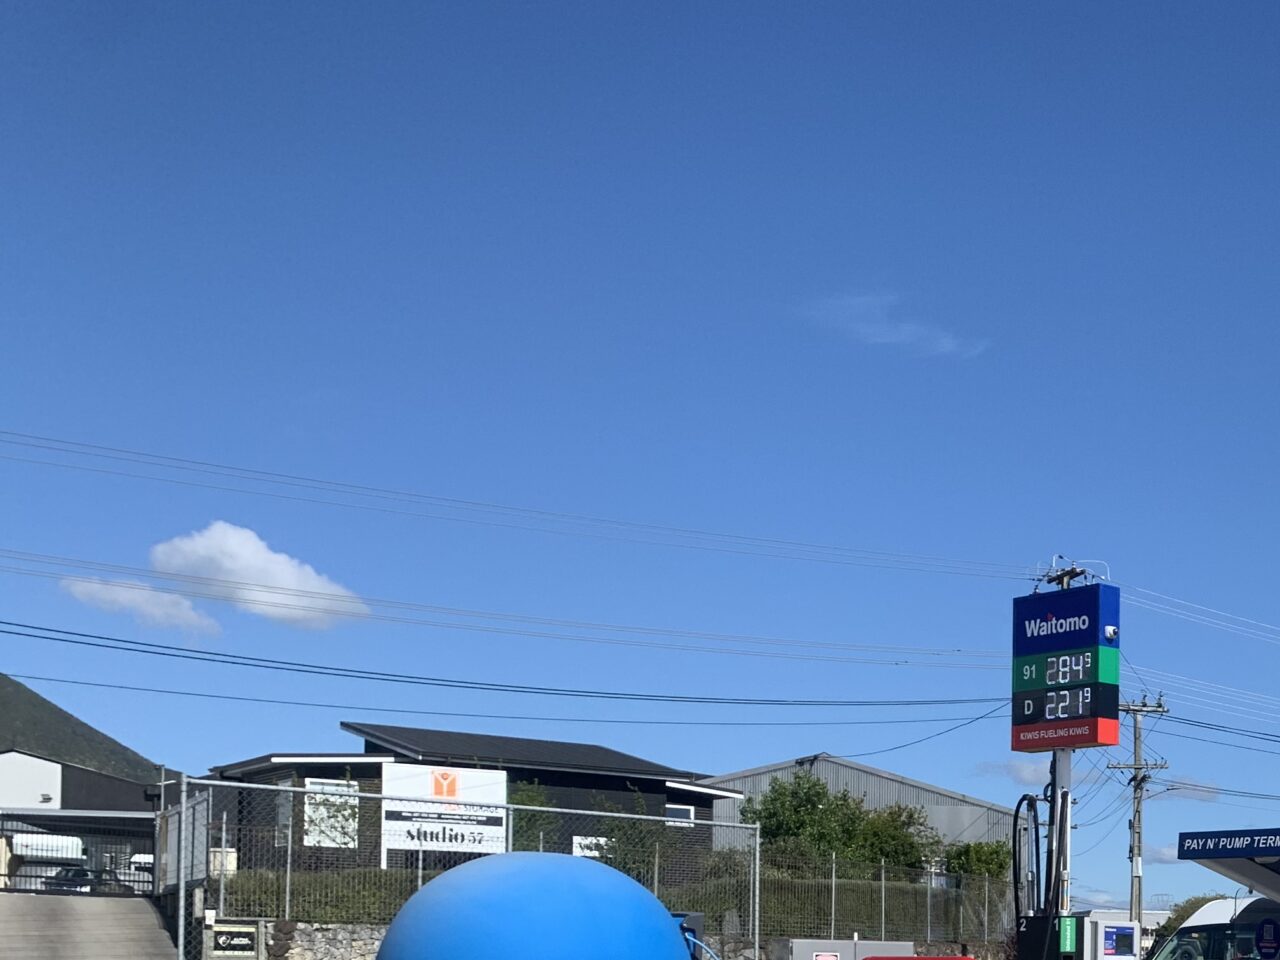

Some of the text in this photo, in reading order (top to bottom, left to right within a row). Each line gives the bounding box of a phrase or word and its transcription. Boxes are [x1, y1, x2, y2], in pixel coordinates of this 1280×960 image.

[1025, 615, 1089, 637] Waitomo
[1023, 665, 1036, 679] 91
[1024, 700, 1033, 715] D
[1020, 726, 1089, 740] KIWIS FUELING KIWIS
[1184, 839, 1206, 850] PAY
[1219, 837, 1251, 849] PUMP
[1020, 918, 1027, 931] 2
[1053, 917, 1059, 931] 1
